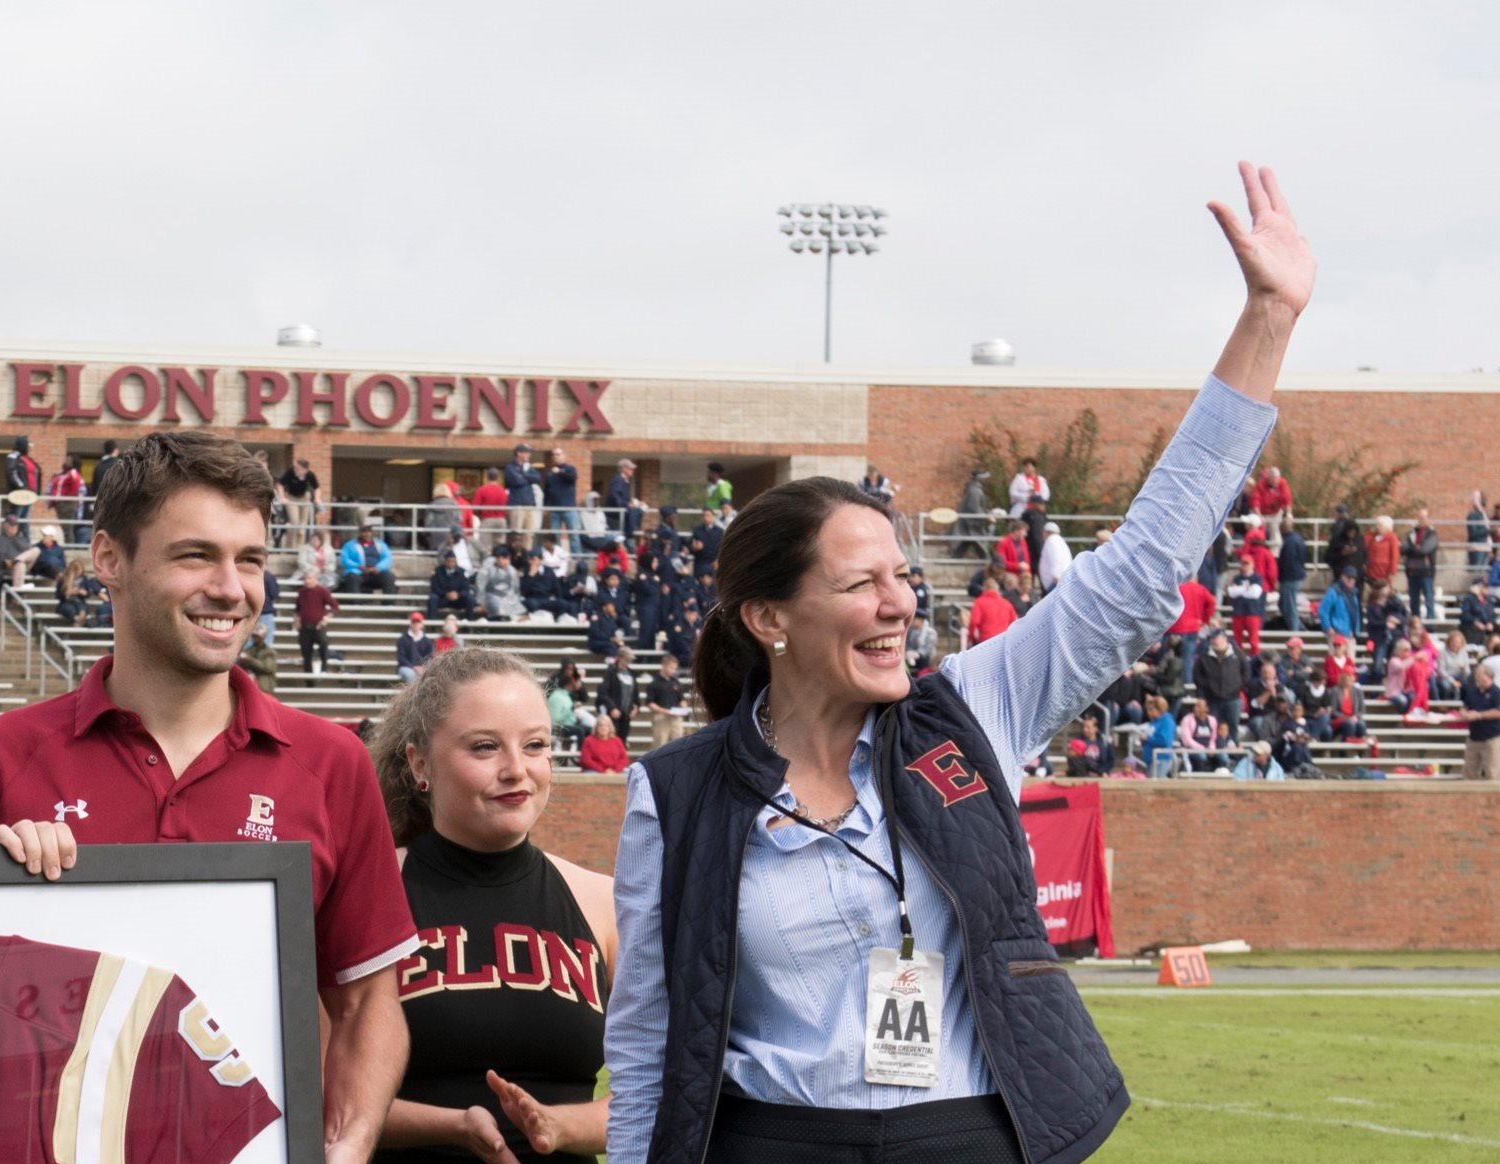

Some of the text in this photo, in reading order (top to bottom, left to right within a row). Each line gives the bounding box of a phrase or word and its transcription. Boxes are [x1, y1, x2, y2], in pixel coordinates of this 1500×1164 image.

[9, 362, 615, 435] ELON PHOENIX
[904, 739, 989, 808] E
[246, 793, 275, 826] E
[237, 828, 278, 842] SOCCER
[245, 821, 273, 835] ELON
[396, 922, 604, 1014] ELON
[1172, 953, 1207, 985] 50
[876, 998, 931, 1043] AA
[873, 1043, 897, 1051] SEASON
[898, 1045, 934, 1055] CREDENTIAL
